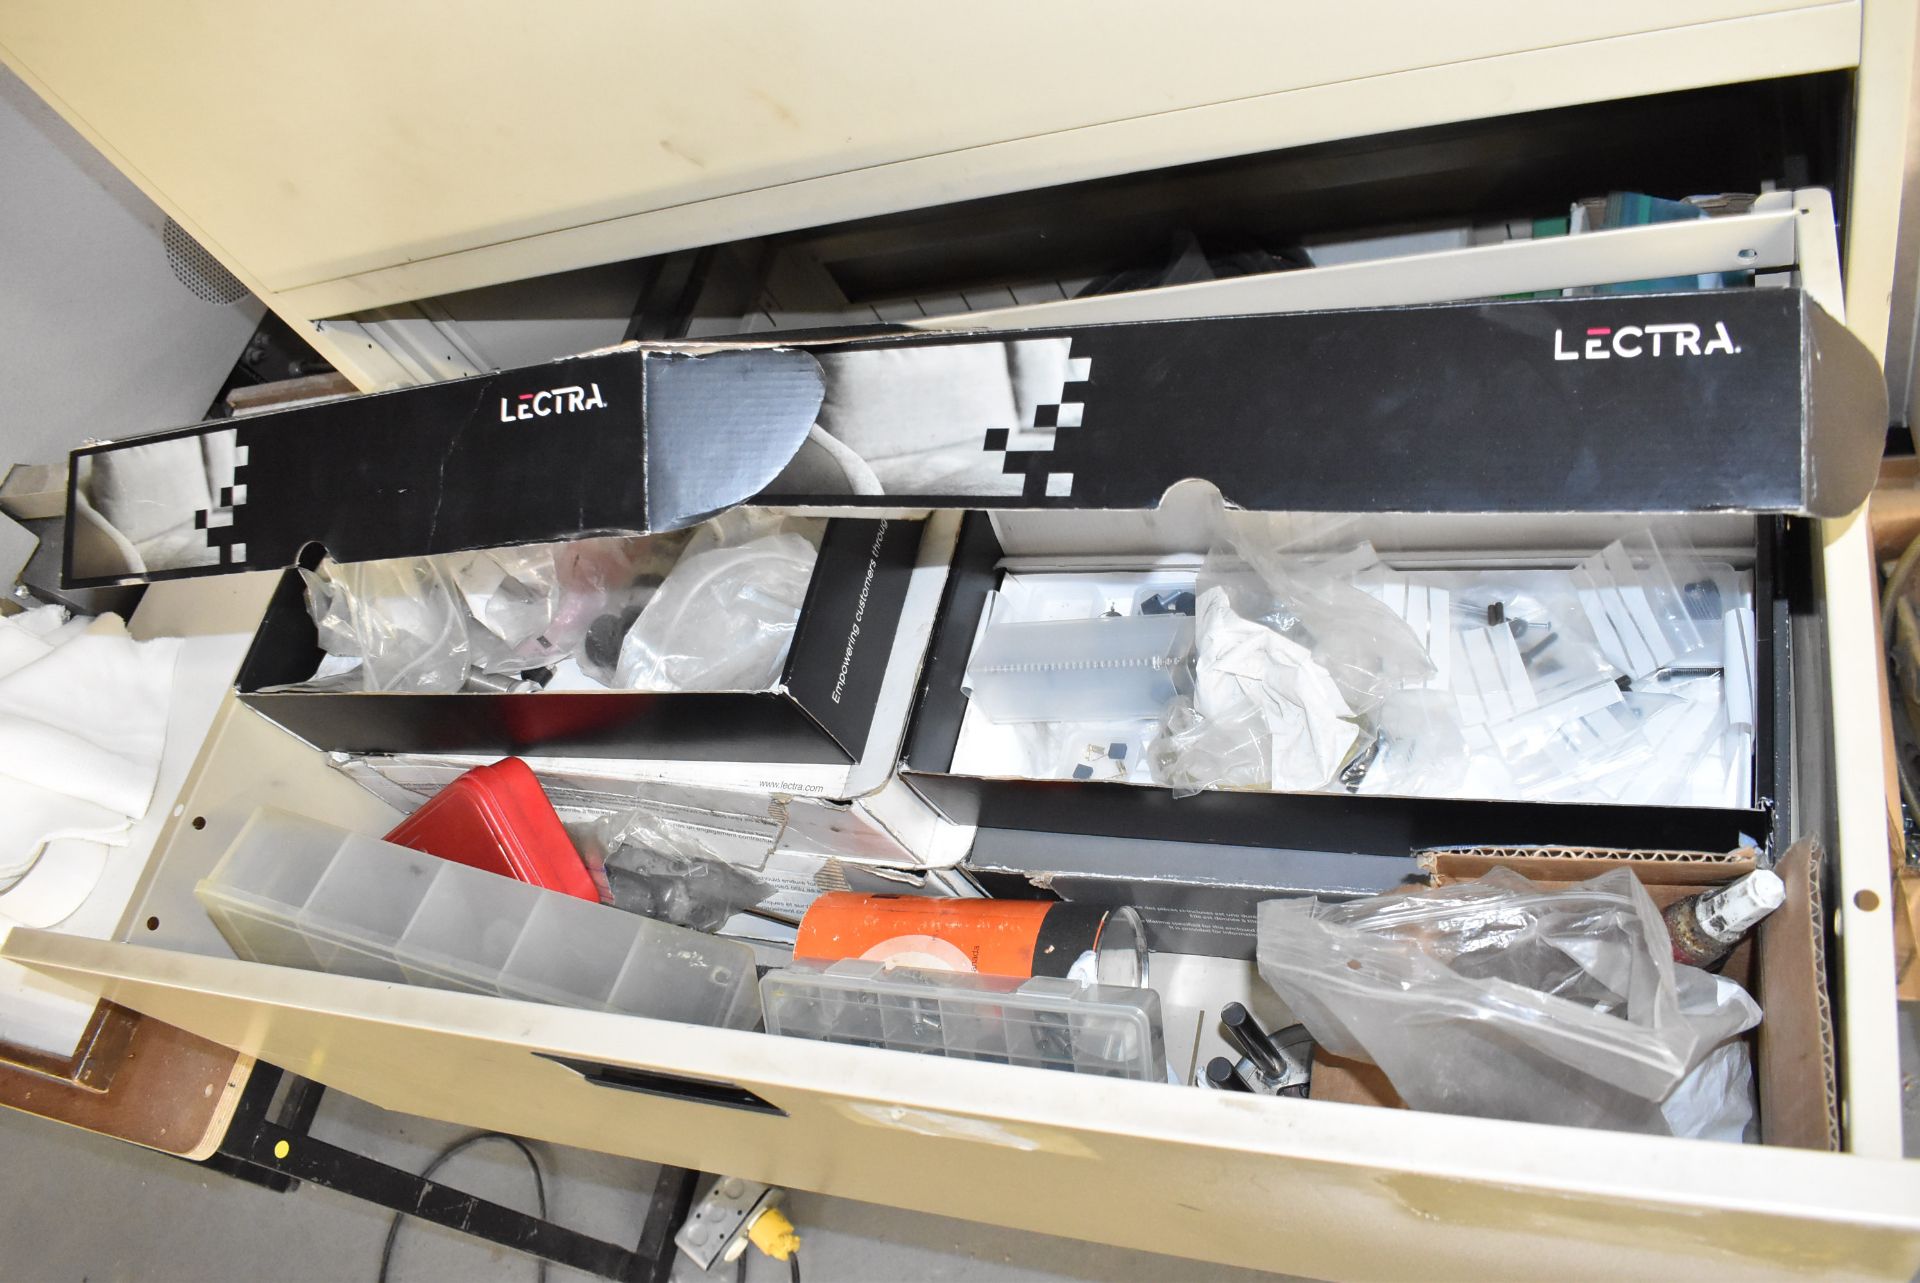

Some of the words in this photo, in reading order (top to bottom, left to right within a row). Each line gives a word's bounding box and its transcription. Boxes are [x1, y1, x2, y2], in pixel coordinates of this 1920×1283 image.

[831, 622, 860, 704] Empowering
[855, 558, 877, 622] customers
[871, 518, 889, 558] throug
[759, 780, 824, 793] www.lectra.com
